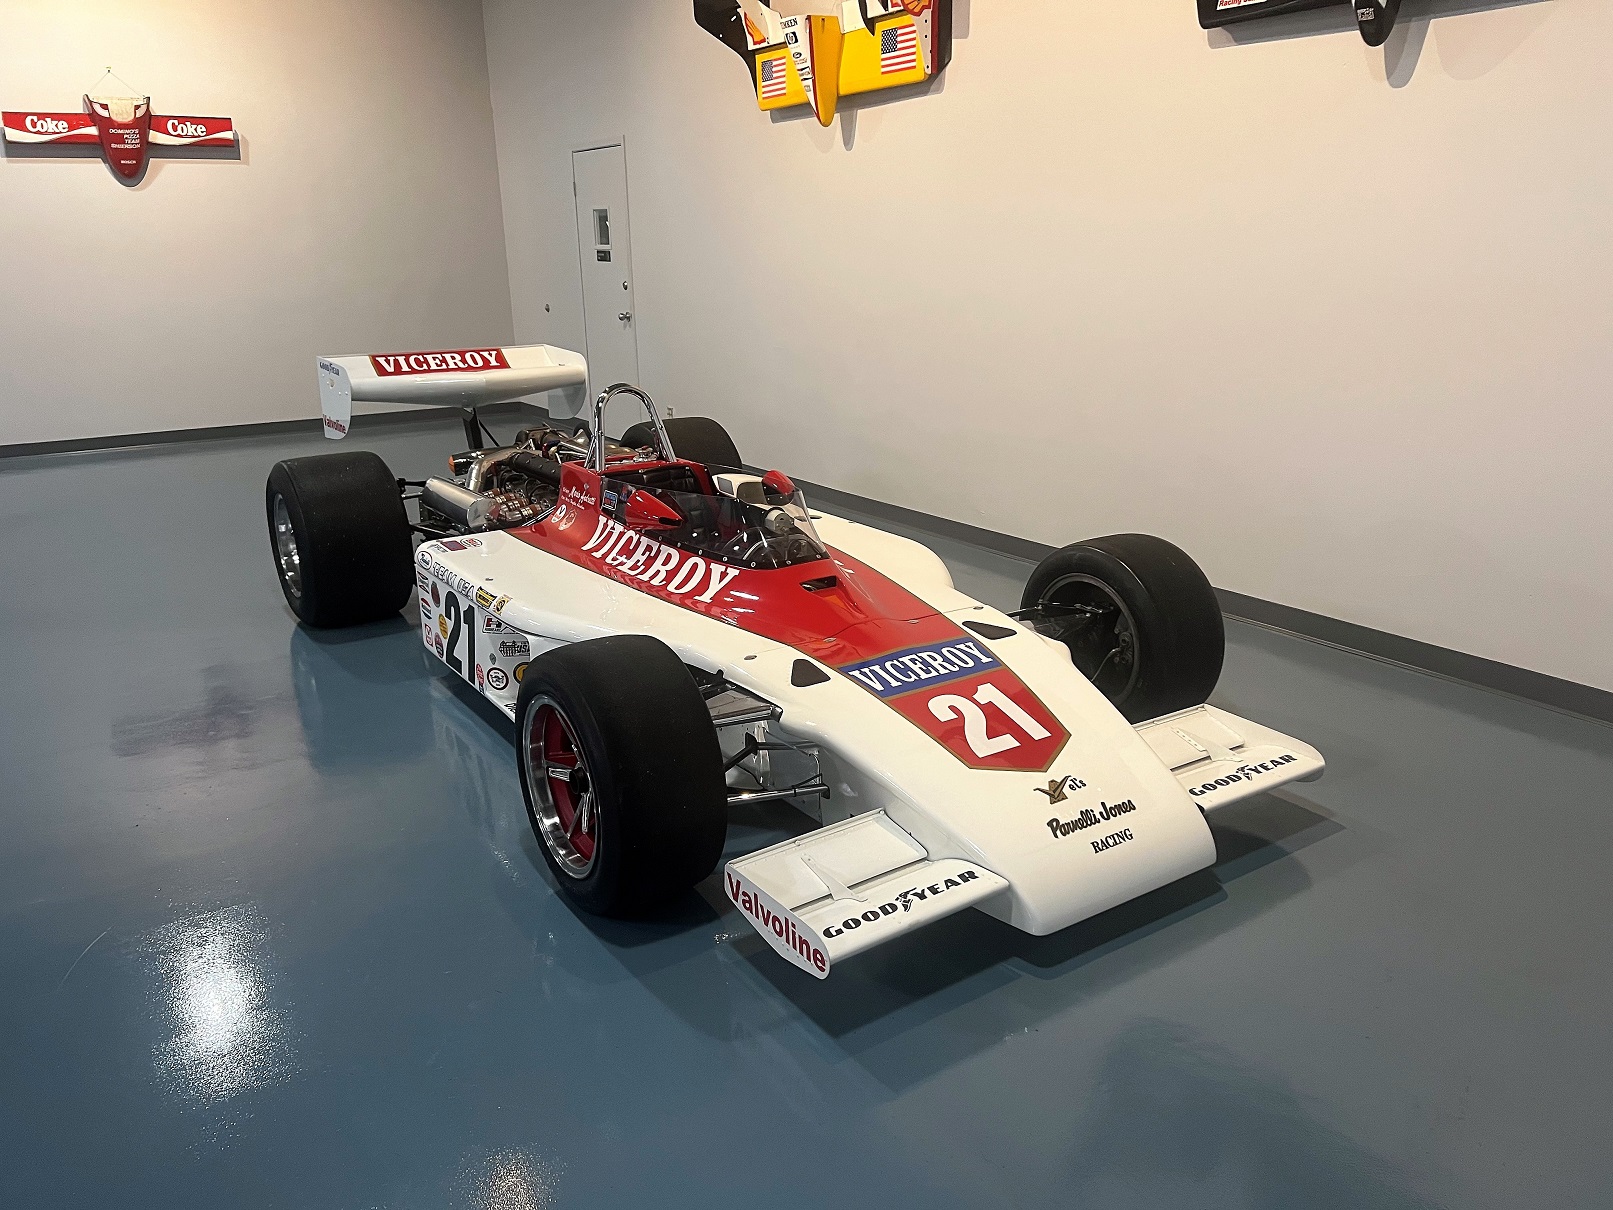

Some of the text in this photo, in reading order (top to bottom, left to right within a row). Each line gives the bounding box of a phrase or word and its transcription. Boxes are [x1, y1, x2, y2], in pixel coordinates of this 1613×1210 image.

[25, 115, 69, 133] Coke
[166, 119, 207, 136] Coke
[375, 350, 500, 373] VICEROY
[581, 514, 740, 604] VICEROY
[444, 590, 476, 686] 21
[849, 641, 994, 692] VICEROY
[927, 682, 1052, 758] 21
[1046, 799, 1137, 839] Parnelli Jones
[1090, 828, 1134, 854] RACING
[726, 872, 826, 973] Valvoline
